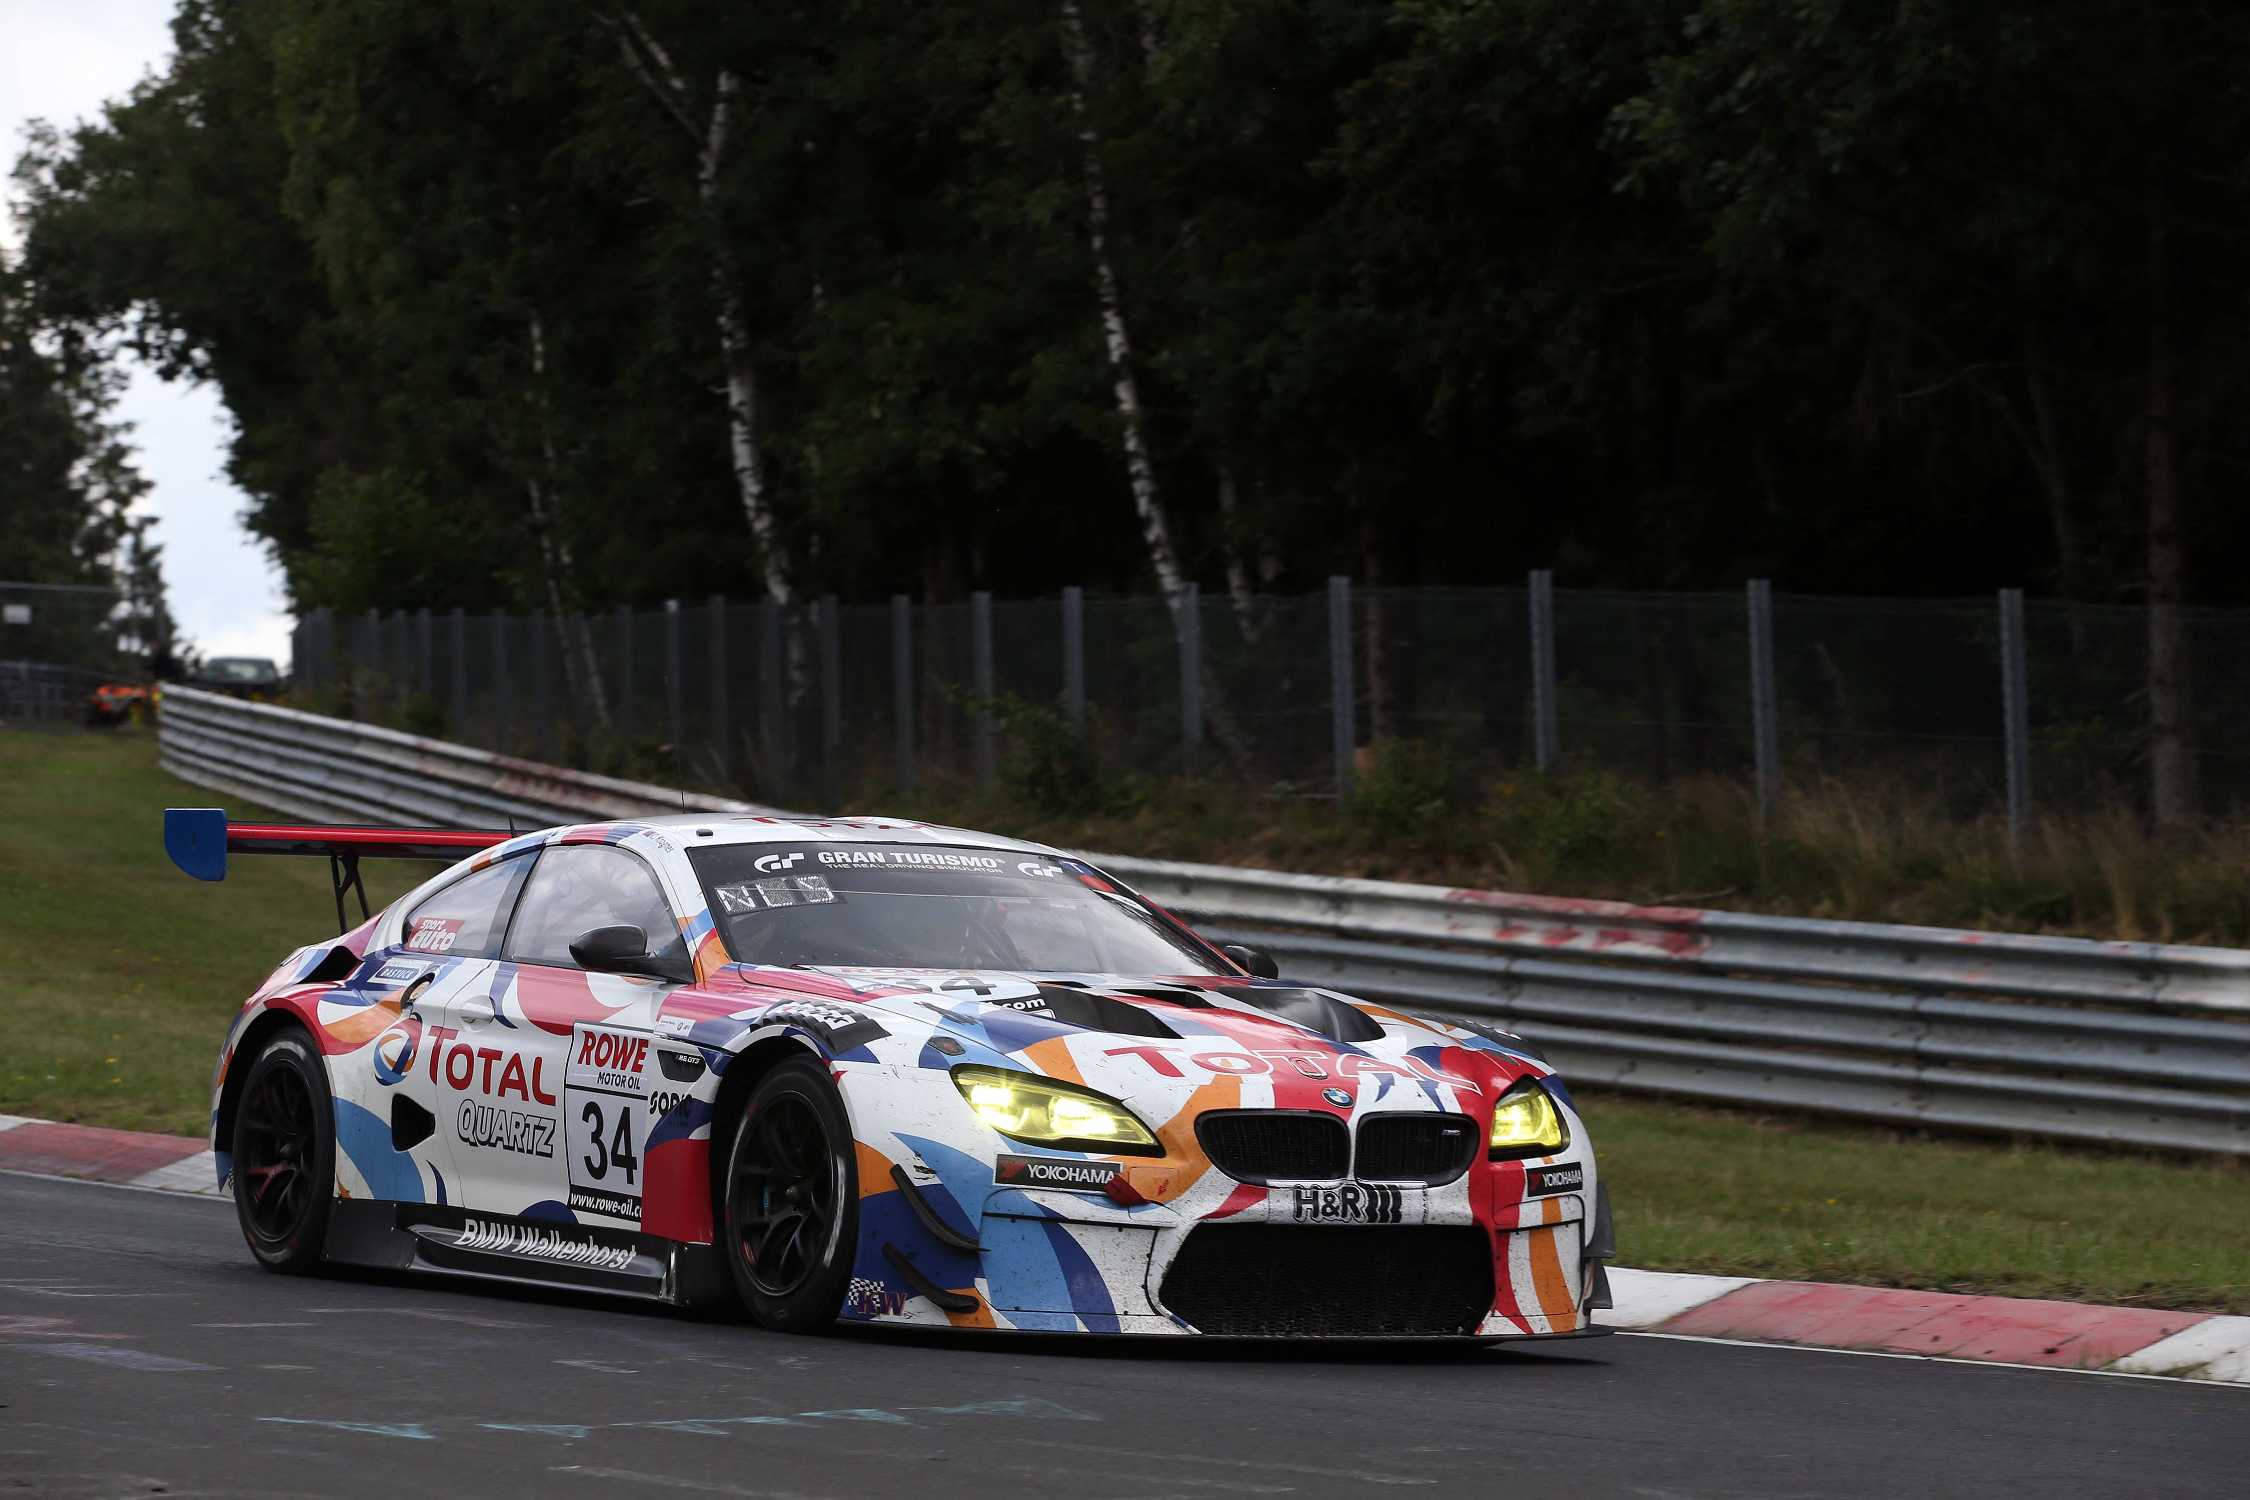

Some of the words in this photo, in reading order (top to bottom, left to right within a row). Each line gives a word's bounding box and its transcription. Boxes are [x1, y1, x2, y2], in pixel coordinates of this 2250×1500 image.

[817, 851, 886, 864] GRAN
[890, 852, 997, 868] TURISMO
[409, 928, 457, 951] auto
[427, 1025, 557, 1106] TOTAL
[577, 1030, 649, 1074] ROWE
[1104, 1045, 1483, 1097] TOTAL
[597, 1071, 627, 1088] MOTOR
[628, 1075, 641, 1091] OIL
[457, 1098, 558, 1158] QUARTZ
[581, 1101, 638, 1186] 34
[1027, 1163, 1115, 1184] YOKOHAMA
[453, 1218, 516, 1251] BMW
[511, 1225, 637, 1270] Walkenhorst
